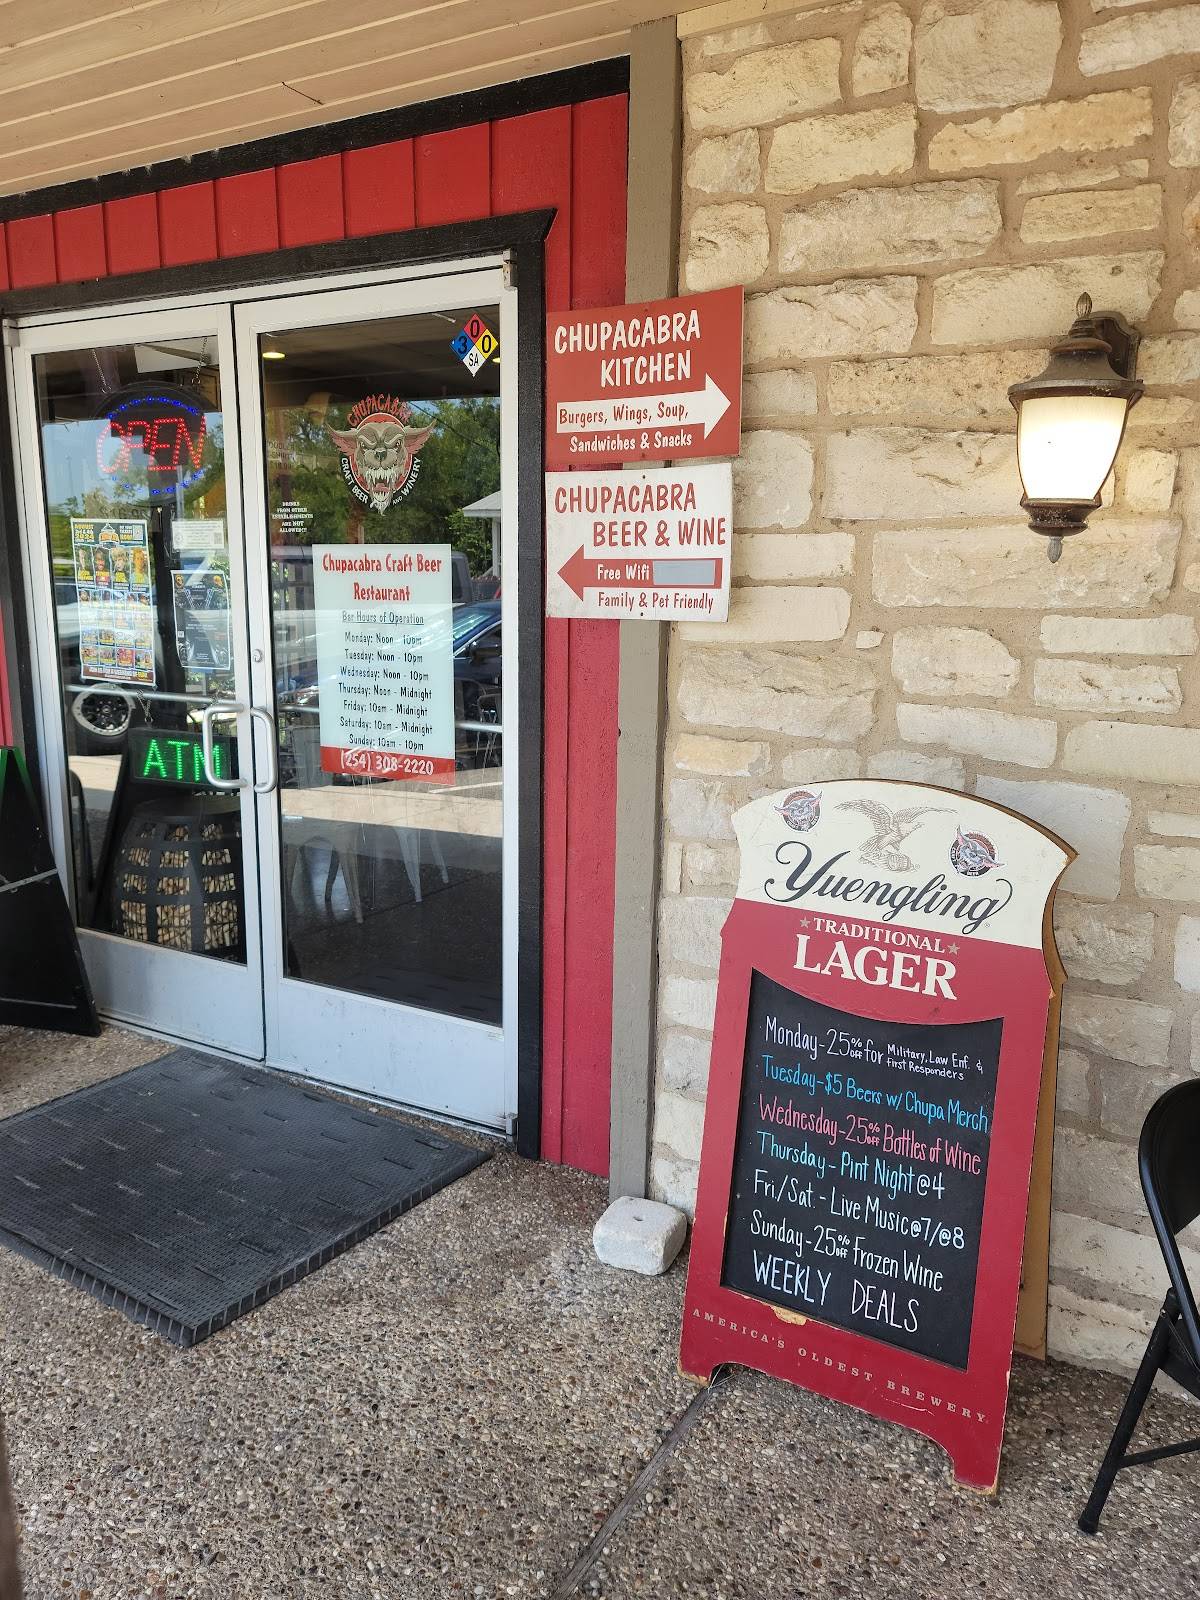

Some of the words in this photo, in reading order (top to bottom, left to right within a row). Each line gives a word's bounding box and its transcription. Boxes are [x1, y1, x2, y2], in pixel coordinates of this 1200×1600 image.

[470, 320, 480, 338] 0
[554, 310, 700, 354] CHUPACABRA
[458, 336, 468, 354] 3
[482, 335, 491, 353] 0
[469, 353, 479, 367] SA
[601, 350, 691, 388] KITCHEN
[346, 394, 412, 426] CHUPACABRA
[559, 408, 608, 428] Burgers,
[613, 404, 652, 424] Wings,
[658, 402, 688, 421] Soup,
[96, 415, 207, 473] OPEN
[570, 434, 636, 453] Sandwiches
[640, 432, 650, 450] &
[654, 429, 692, 448] Snacks
[341, 457, 354, 486] CRAFT
[351, 485, 369, 504] BEER
[400, 457, 421, 496] WINERY
[554, 482, 696, 514] CHUPACABRA
[593, 520, 648, 547] BEER
[655, 520, 670, 547] &
[678, 517, 726, 546] WINE
[322, 553, 381, 574] Chupacabra
[385, 553, 413, 572] Craft
[417, 554, 442, 573] Beer
[597, 564, 621, 581] Free
[626, 563, 649, 580] Wifi
[353, 582, 410, 601] Restaurant
[598, 592, 635, 612] Family
[639, 592, 648, 608] &
[652, 592, 669, 608] Pet
[674, 592, 714, 614] Friendly
[342, 610, 355, 622] Bar
[356, 612, 377, 623] Hours
[380, 612, 387, 623] of
[389, 612, 424, 626] Operation
[345, 632, 373, 646] Monday:
[376, 632, 394, 643] Noon
[403, 634, 421, 646] 10pm
[345, 649, 374, 663] Tuesday:
[377, 650, 395, 662] Noon
[404, 652, 423, 664] 10pm
[340, 666, 380, 680] Wednesday:
[383, 669, 400, 680] Noon
[410, 671, 429, 682] 10pm
[339, 682, 371, 697] Thursday:
[400, 686, 432, 700] Midnight
[343, 700, 367, 714] Friday:
[370, 702, 387, 713] 10am
[396, 703, 428, 718] Midnight
[340, 716, 372, 732] Saturday:
[374, 720, 392, 731] 10am
[401, 721, 432, 736] Midnight
[348, 734, 376, 748] Sunday:
[378, 736, 396, 748] 10am
[405, 739, 423, 751] 10pm
[144, 739, 222, 784] ATM
[341, 749, 371, 770] (254)
[376, 753, 433, 776] 308-2220
[764, 840, 1013, 935] Yuengling
[813, 918, 946, 954] TRADITIONAL
[793, 932, 958, 1001] LAGER
[864, 1039, 884, 1065] for
[930, 1050, 948, 1066] Law
[952, 1052, 970, 1070] Enf.
[909, 1062, 964, 1081] Responders
[846, 1078, 882, 1104] Beers
[886, 1093, 903, 1111] w/
[905, 1090, 944, 1124] Chupa
[947, 1099, 988, 1134] Merch
[884, 1123, 926, 1161] Bottles
[930, 1138, 942, 1164] of
[945, 1139, 981, 1176] Wine
[841, 1151, 870, 1181] Pint
[831, 1186, 860, 1220] Live
[854, 1236, 899, 1279] Frozen
[903, 1250, 943, 1292] Wine
[754, 1249, 831, 1306] WEEKLY
[852, 1278, 919, 1332] DEALS
[693, 1308, 786, 1349] AMERICA'S
[798, 1347, 873, 1381] OLDEST
[887, 1380, 987, 1423] BREWERY
